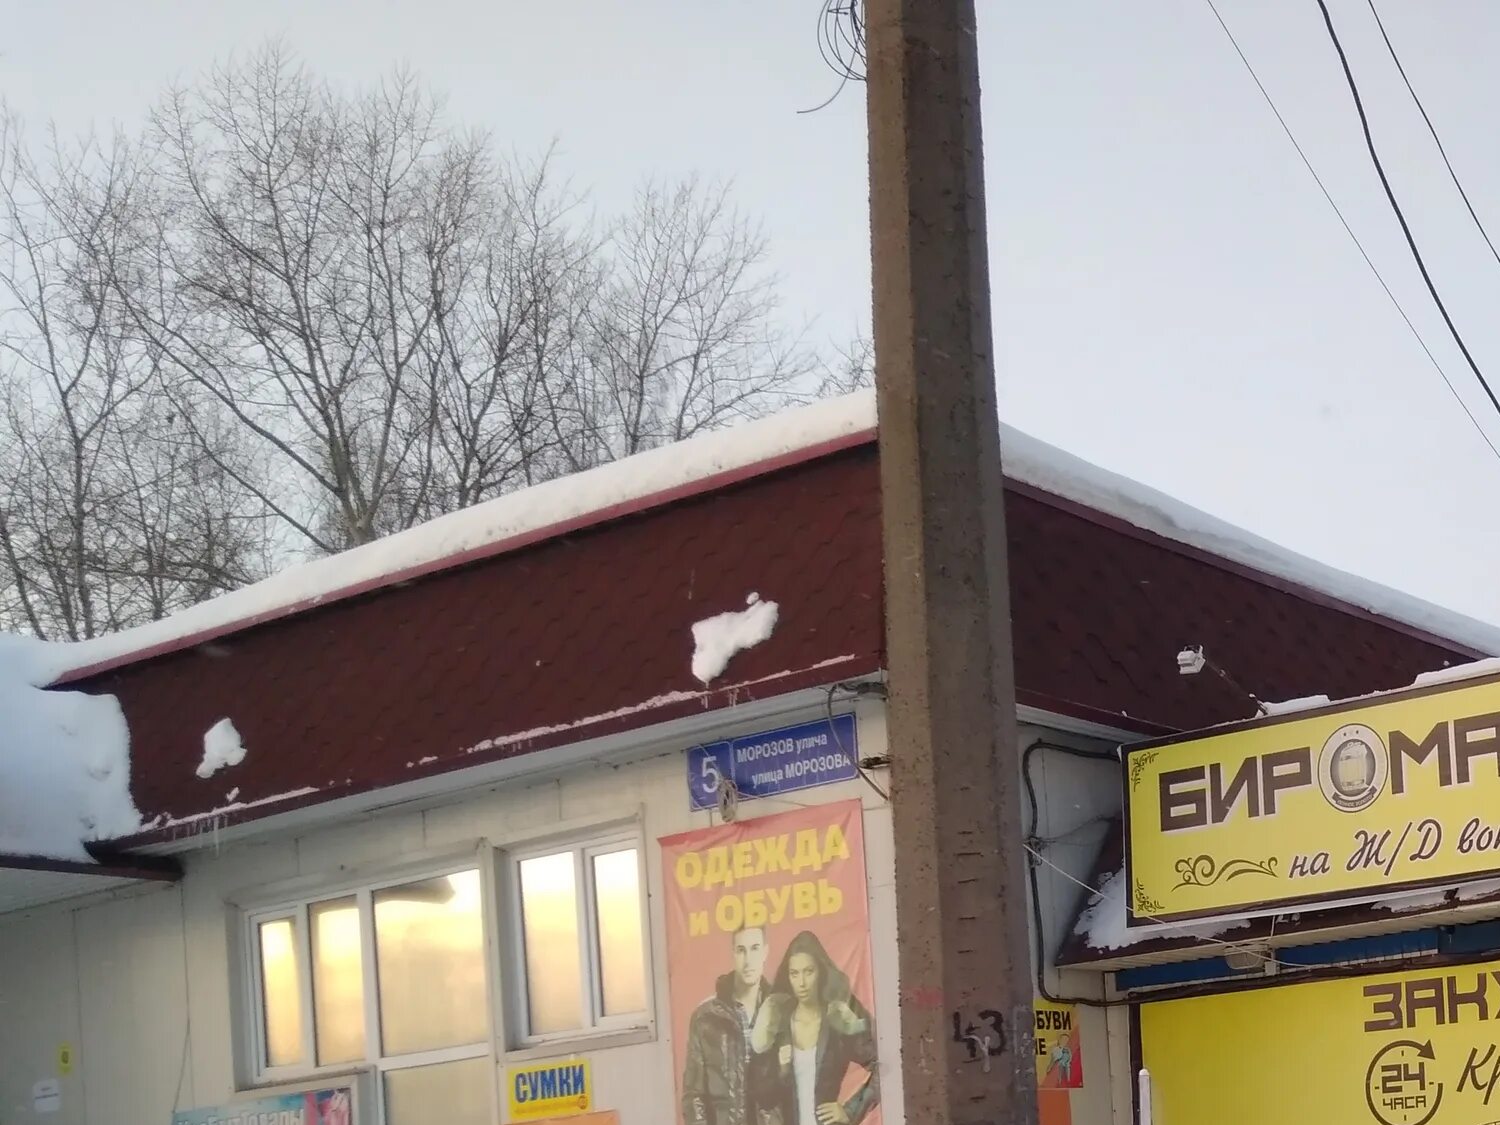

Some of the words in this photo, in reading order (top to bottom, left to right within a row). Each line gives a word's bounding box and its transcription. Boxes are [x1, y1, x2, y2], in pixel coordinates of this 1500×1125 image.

[737, 738, 793, 763] МОРОЗОВ
[796, 733, 828, 754] улича
[702, 756, 719, 793] 5
[752, 768, 783, 788] улица
[785, 753, 851, 779] МОРОЗОВА
[676, 825, 850, 888] ОДЕЖДА
[1289, 852, 1330, 879] на
[1347, 818, 1442, 876] Ж/Д
[689, 908, 710, 936] и
[715, 878, 843, 934] ОБУВЬ
[515, 1064, 585, 1103] СУМКИ
[1381, 1062, 1426, 1093] 24
[1382, 1095, 1427, 1110] ЧАСА
